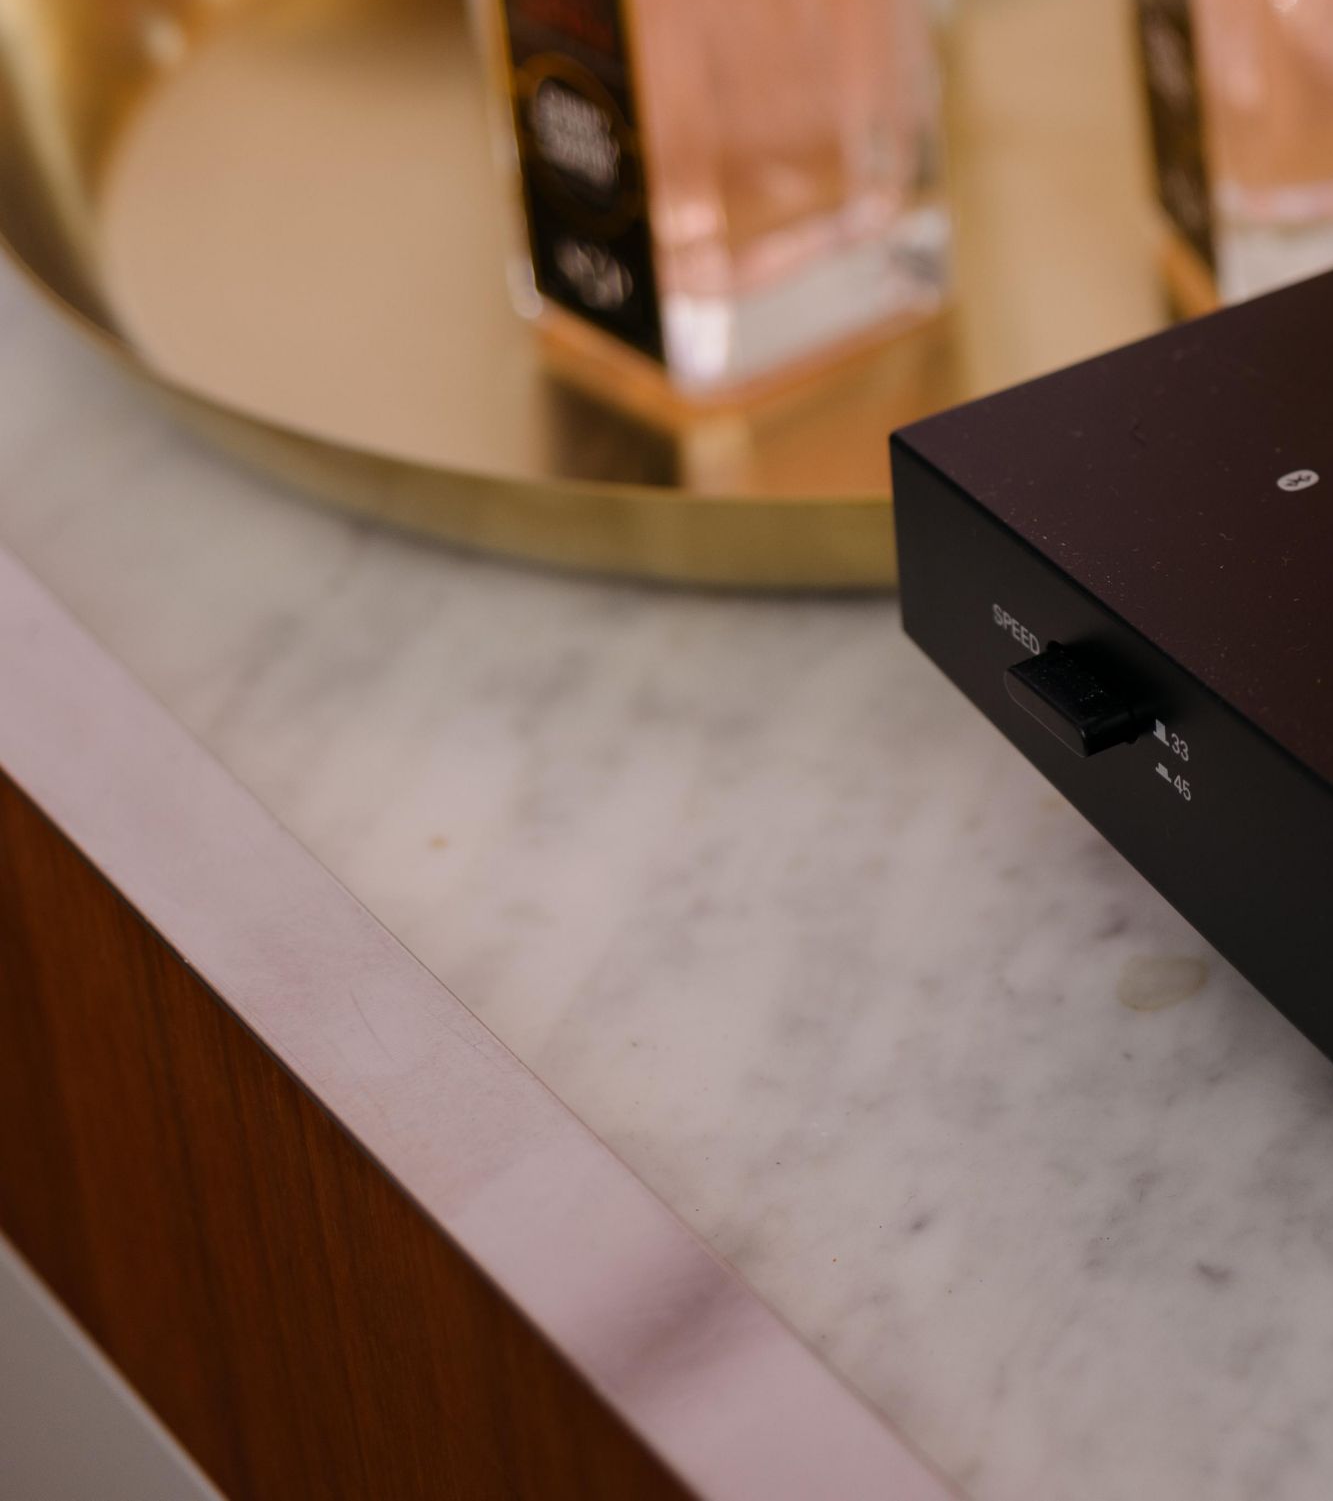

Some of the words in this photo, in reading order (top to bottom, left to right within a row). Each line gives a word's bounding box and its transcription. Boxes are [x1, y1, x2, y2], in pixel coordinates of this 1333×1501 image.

[992, 604, 1041, 655] SPEED
[1171, 734, 1190, 762] 33
[1173, 775, 1192, 802] 45
